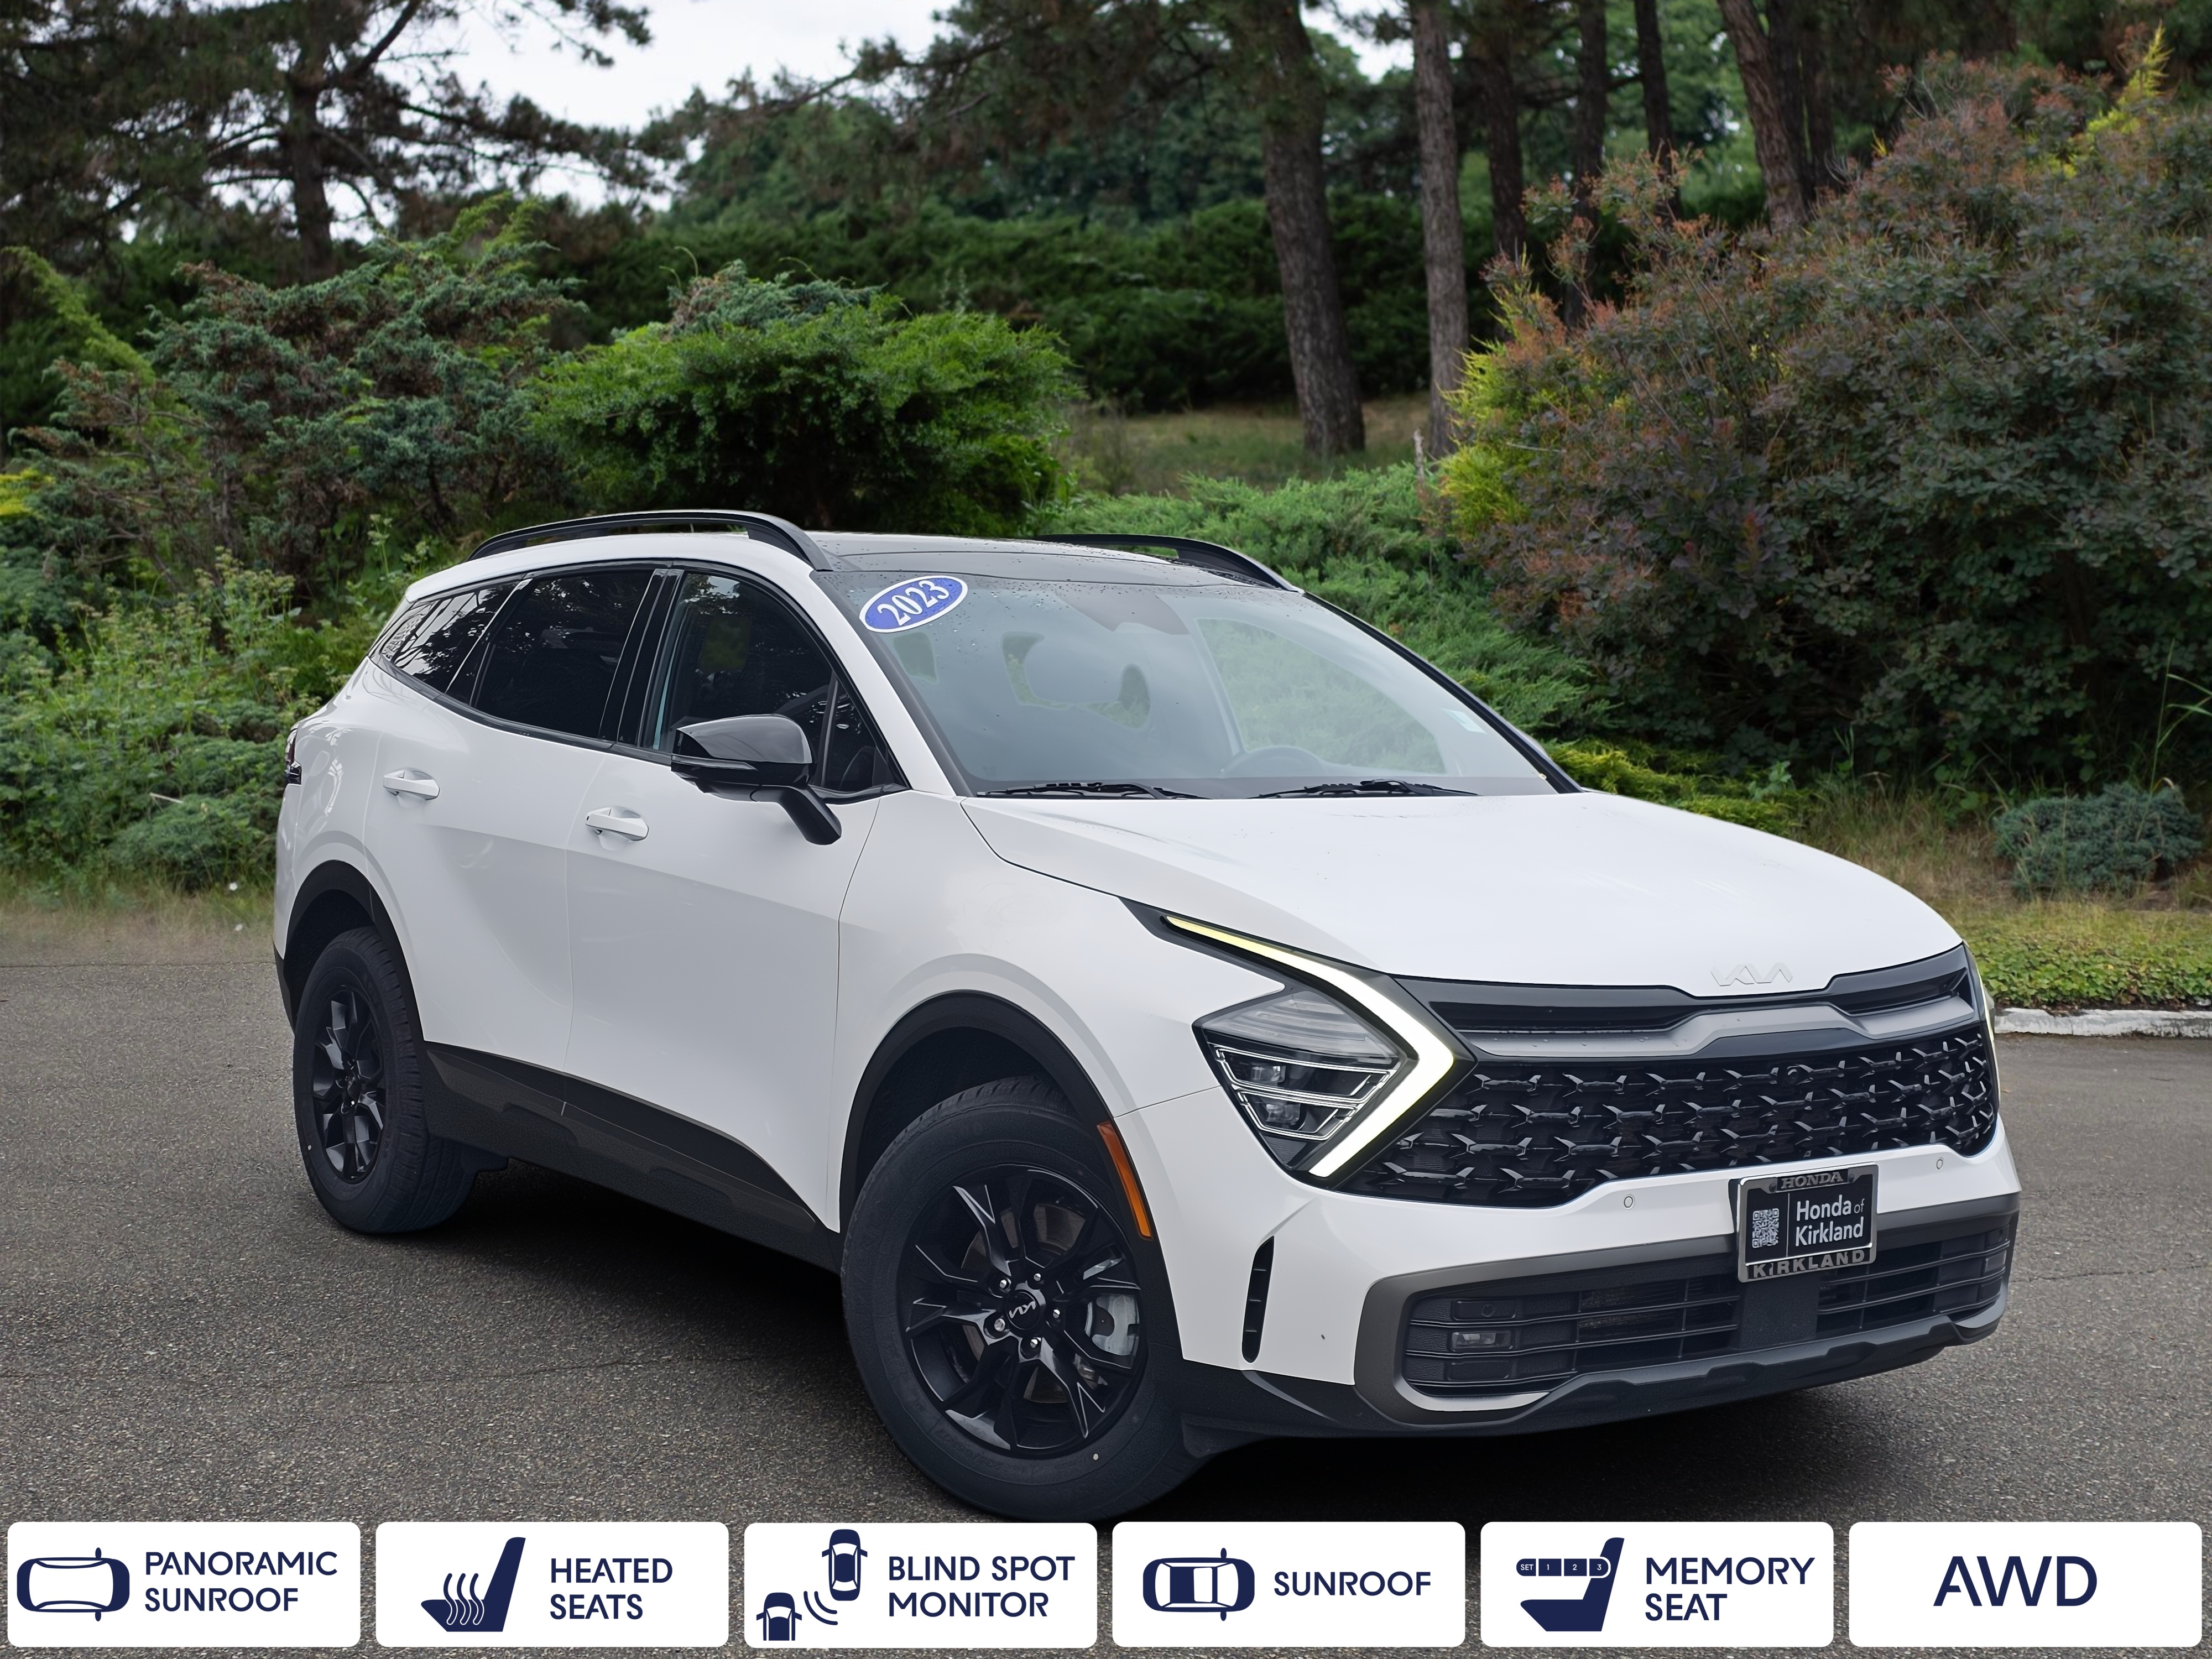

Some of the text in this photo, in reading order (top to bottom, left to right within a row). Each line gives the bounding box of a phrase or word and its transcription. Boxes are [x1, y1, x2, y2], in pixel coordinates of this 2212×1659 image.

[877, 581, 950, 626] 2023
[1711, 962, 1793, 987] KIA
[1781, 1171, 1844, 1189] HONDA
[1796, 1194, 1865, 1222] Honda of
[1795, 1216, 1864, 1247] Kirkland
[1753, 1249, 1865, 1279] KIRKLAND
